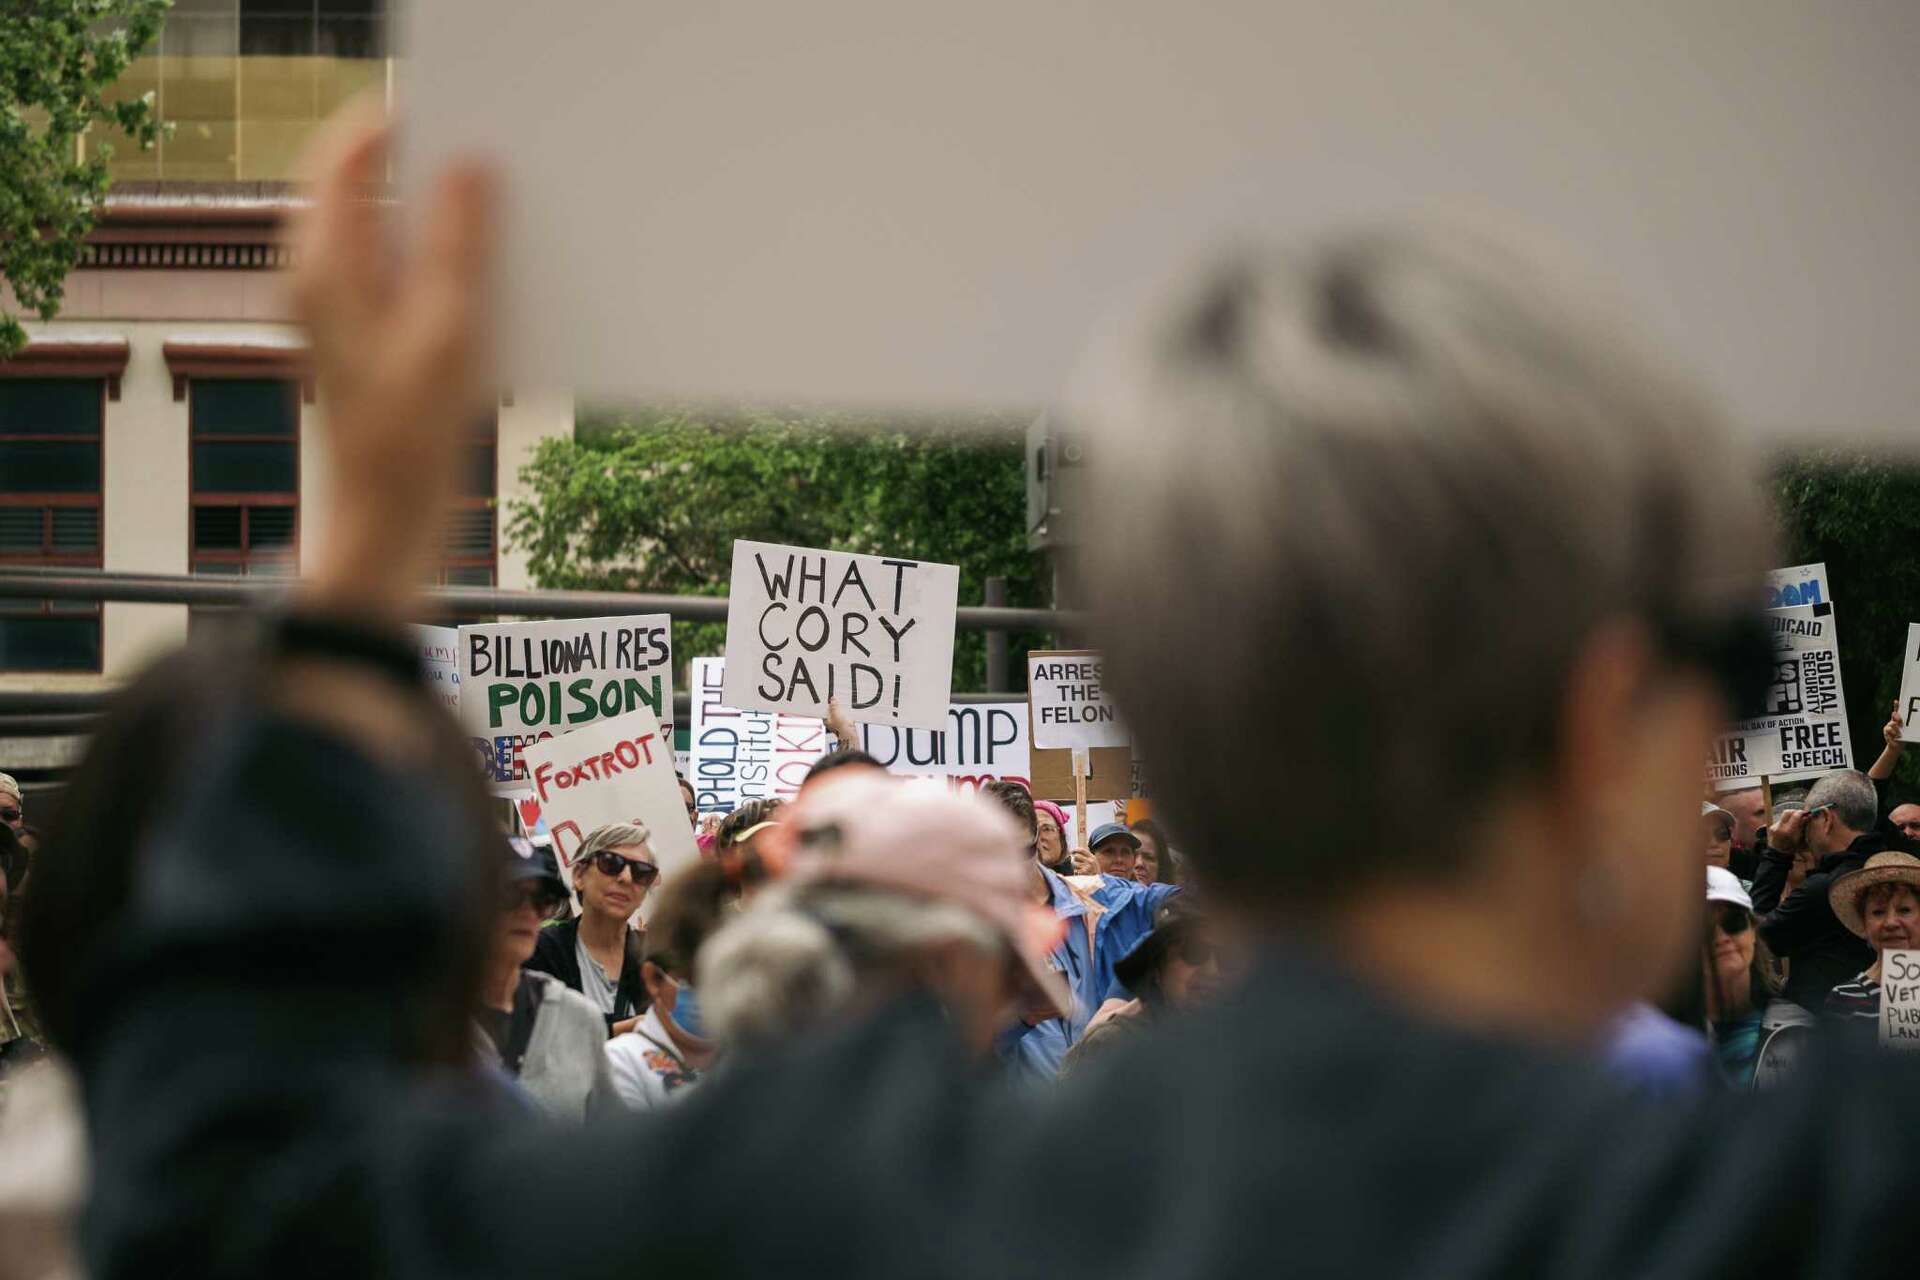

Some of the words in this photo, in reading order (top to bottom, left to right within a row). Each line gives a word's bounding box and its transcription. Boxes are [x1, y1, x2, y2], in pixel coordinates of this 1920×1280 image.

[755, 553, 918, 616] WHAT
[758, 602, 916, 662] CORY
[1772, 616, 1822, 637] DICAID
[470, 627, 669, 679] BILLIONAIRES
[1034, 663, 1104, 681] ARRES
[488, 675, 662, 728] POISON
[758, 653, 901, 718] SAID!
[1057, 684, 1100, 702] THE
[1802, 652, 1825, 714] SECURITY
[1816, 650, 1838, 710] SOCIAL
[1042, 705, 1114, 724] FELON
[1778, 717, 1805, 728] ACTION
[1780, 721, 1843, 751] FREE
[534, 733, 655, 803] FOXTROT
[739, 710, 773, 809] onstitut
[1705, 763, 1748, 778] CTIONS
[1782, 748, 1844, 769] SPEECH
